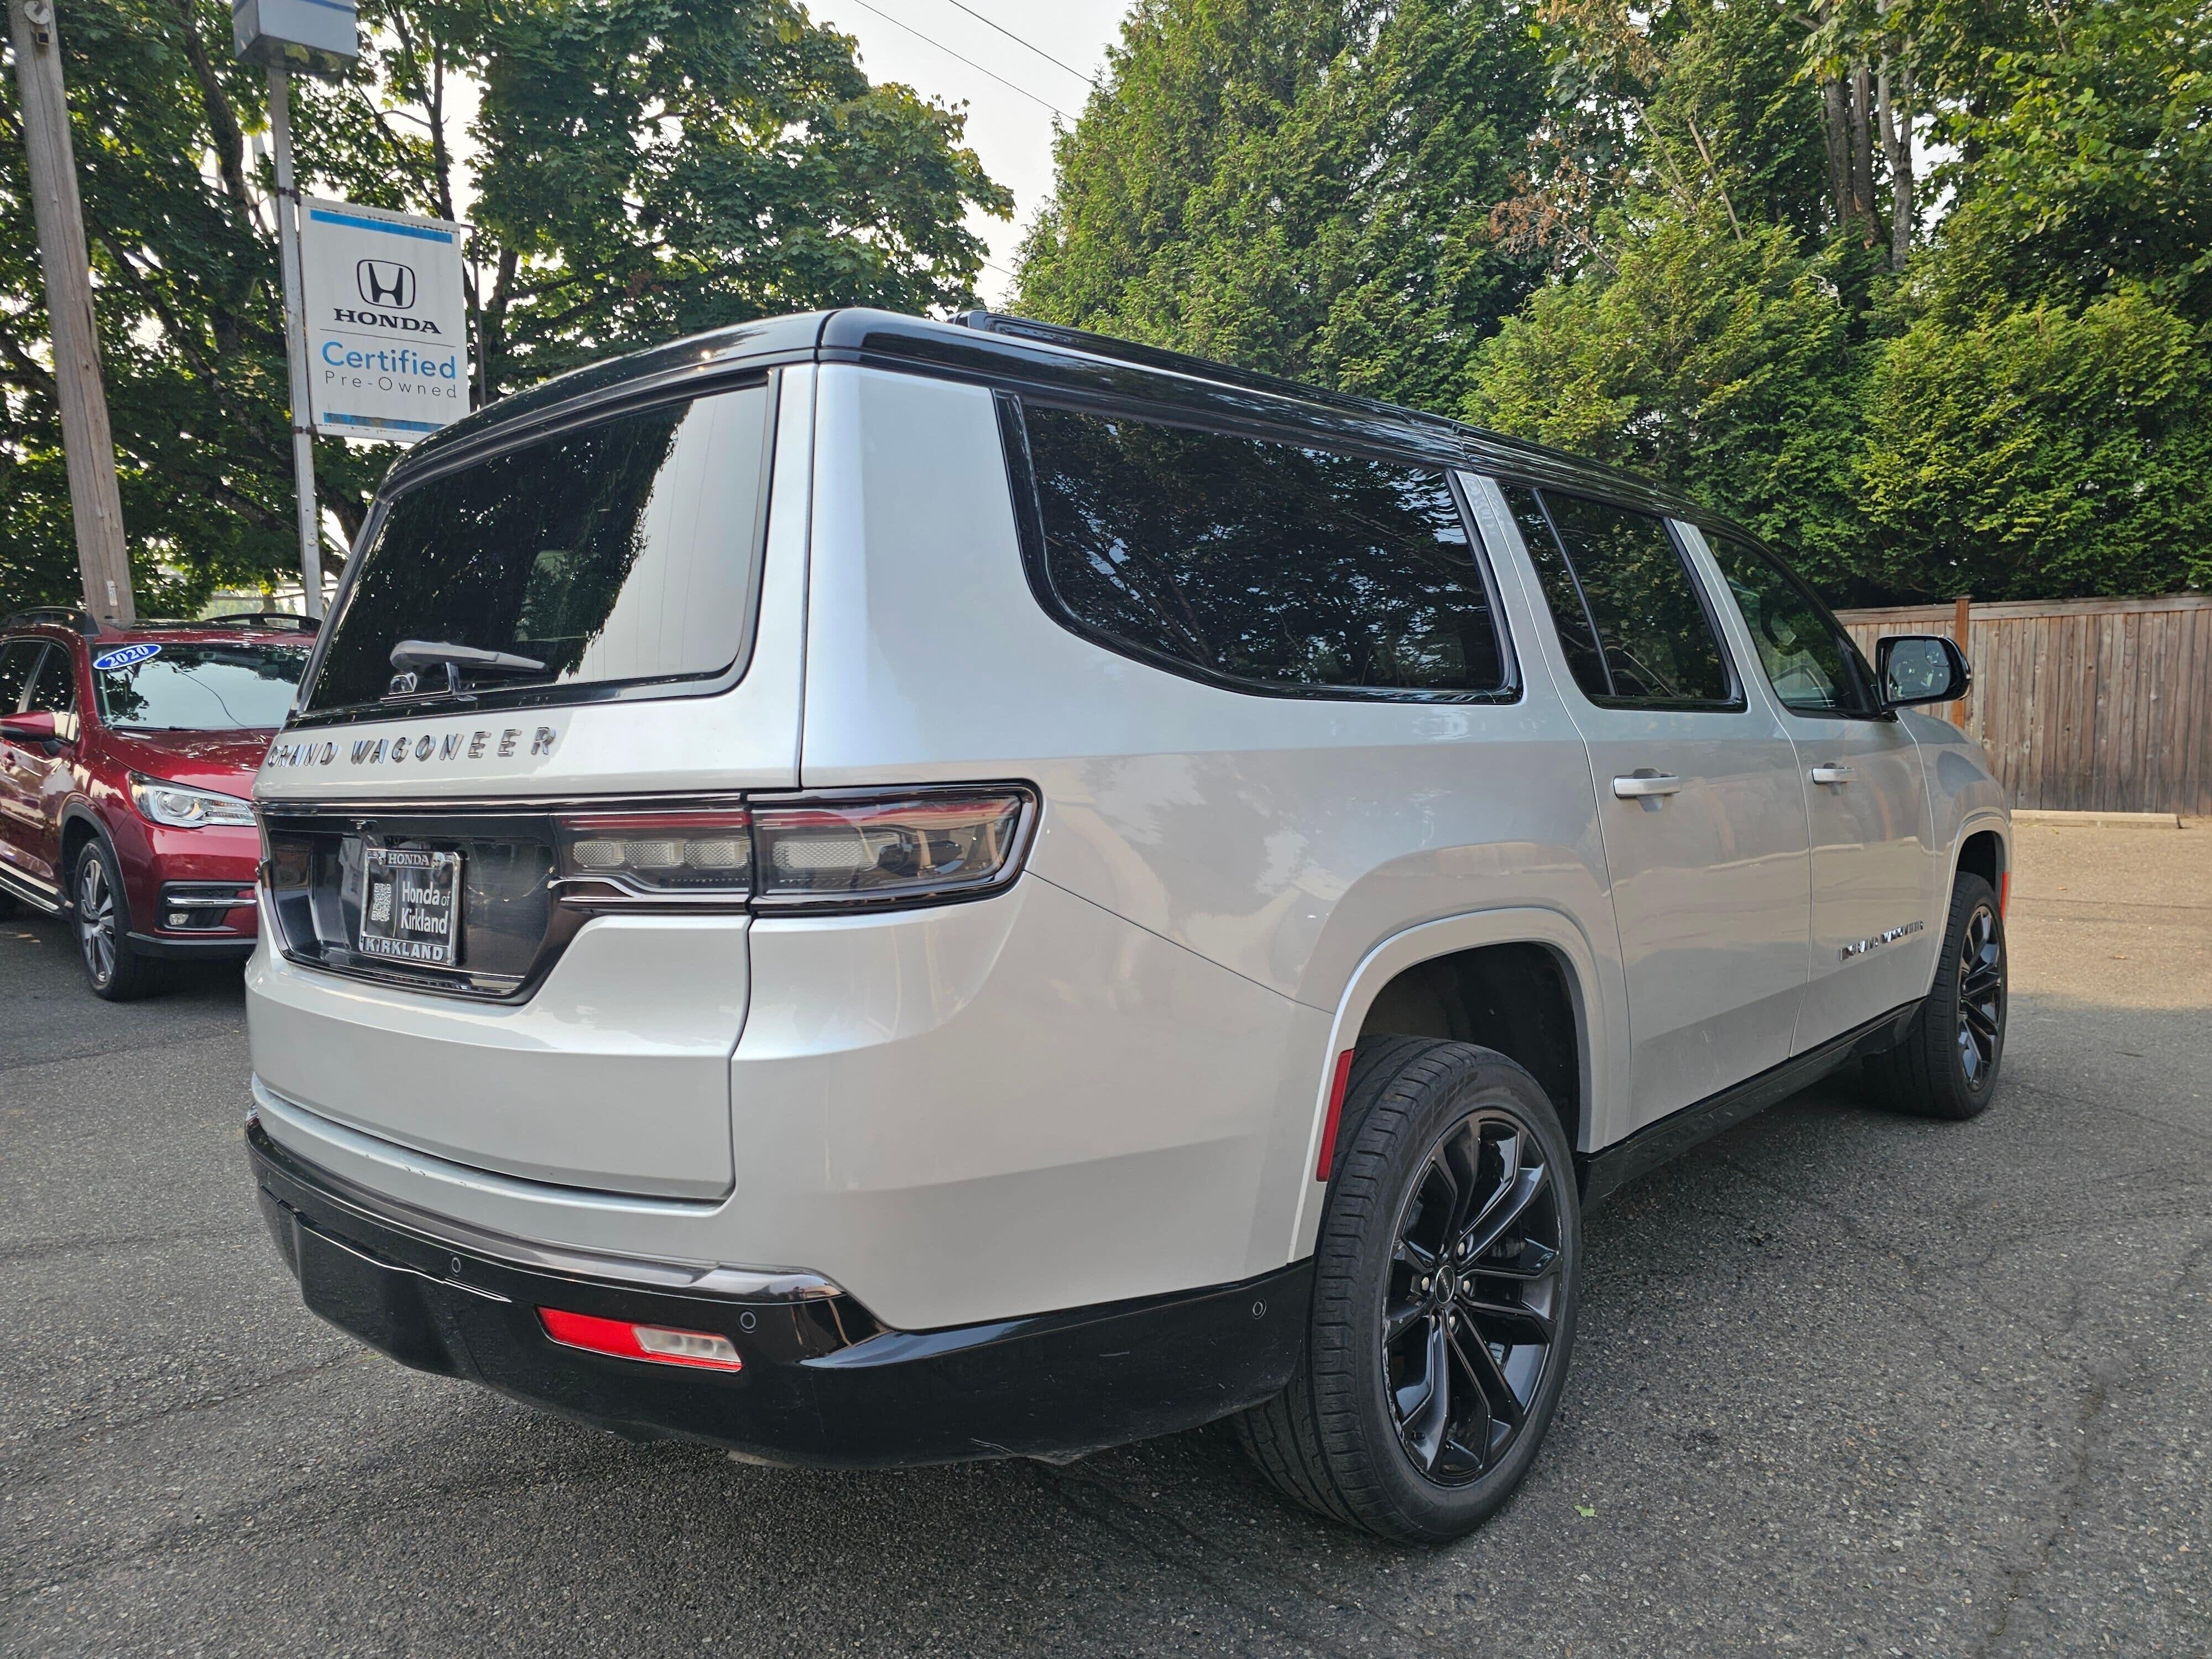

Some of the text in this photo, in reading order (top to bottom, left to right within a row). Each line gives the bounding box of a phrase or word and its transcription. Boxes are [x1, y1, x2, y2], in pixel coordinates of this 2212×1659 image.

[333, 308, 442, 334] HONDA
[322, 341, 456, 379] Certified
[325, 370, 457, 398] Pre-Owned
[105, 646, 149, 667] 2020
[268, 726, 556, 768] GRAND WAGONEER
[388, 852, 431, 866] HONDA
[402, 881, 451, 906] Honda of
[401, 907, 448, 935] Kirkland
[366, 937, 444, 961] KIRKLAND
